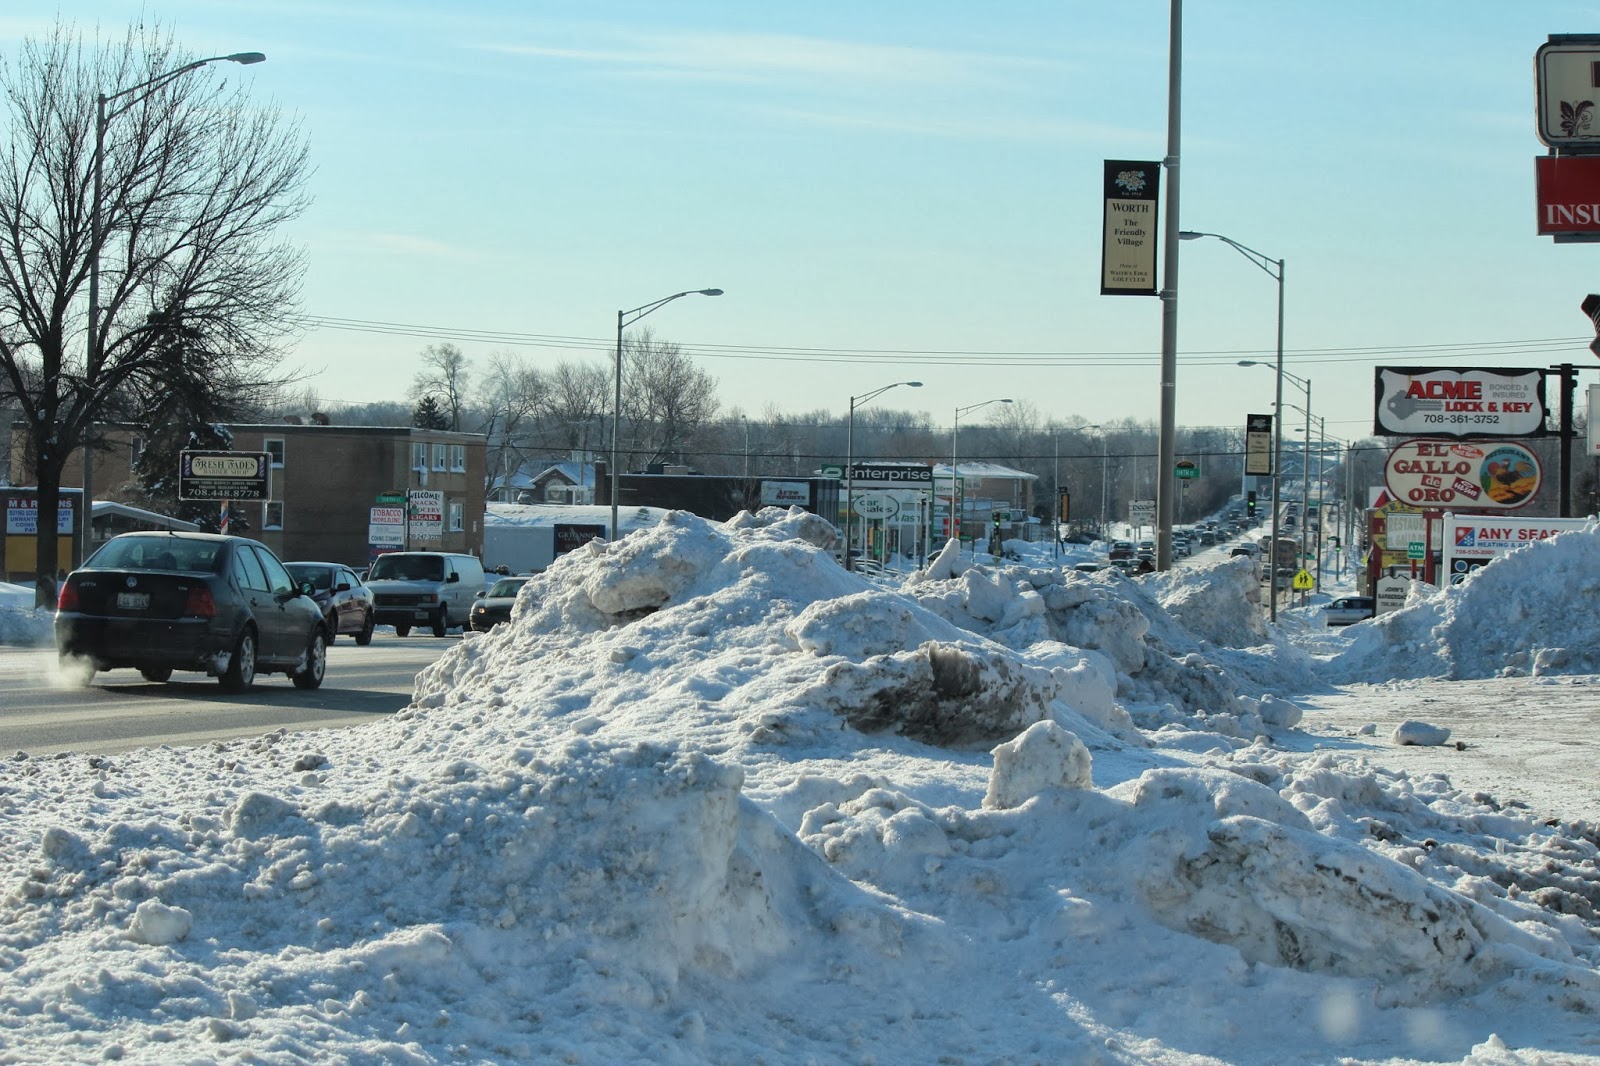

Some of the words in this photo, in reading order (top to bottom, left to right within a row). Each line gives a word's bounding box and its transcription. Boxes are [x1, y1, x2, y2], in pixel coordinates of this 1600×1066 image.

[1112, 203, 1149, 213] WORTH
[1114, 228, 1146, 237] Friendly
[1117, 238, 1144, 247] Village
[1405, 381, 1482, 399] ACME
[1445, 402, 1484, 412] LOCK
[1488, 402, 1498, 412] &
[1503, 402, 1533, 412] KEY
[1424, 414, 1499, 424] 708-361-3752
[1416, 443, 1449, 456] EL
[1485, 449, 1530, 462] RESTAURANT
[195, 458, 224, 470] FRESH
[228, 459, 255, 469] FADES
[1394, 460, 1471, 475] GALLO
[845, 468, 931, 481] Enterprise
[1425, 476, 1440, 487] de
[188, 489, 260, 497] 708.448.8778
[1408, 488, 1455, 502] ORO
[1478, 528, 1513, 539] ANY
[1518, 529, 1560, 540] SEAS
